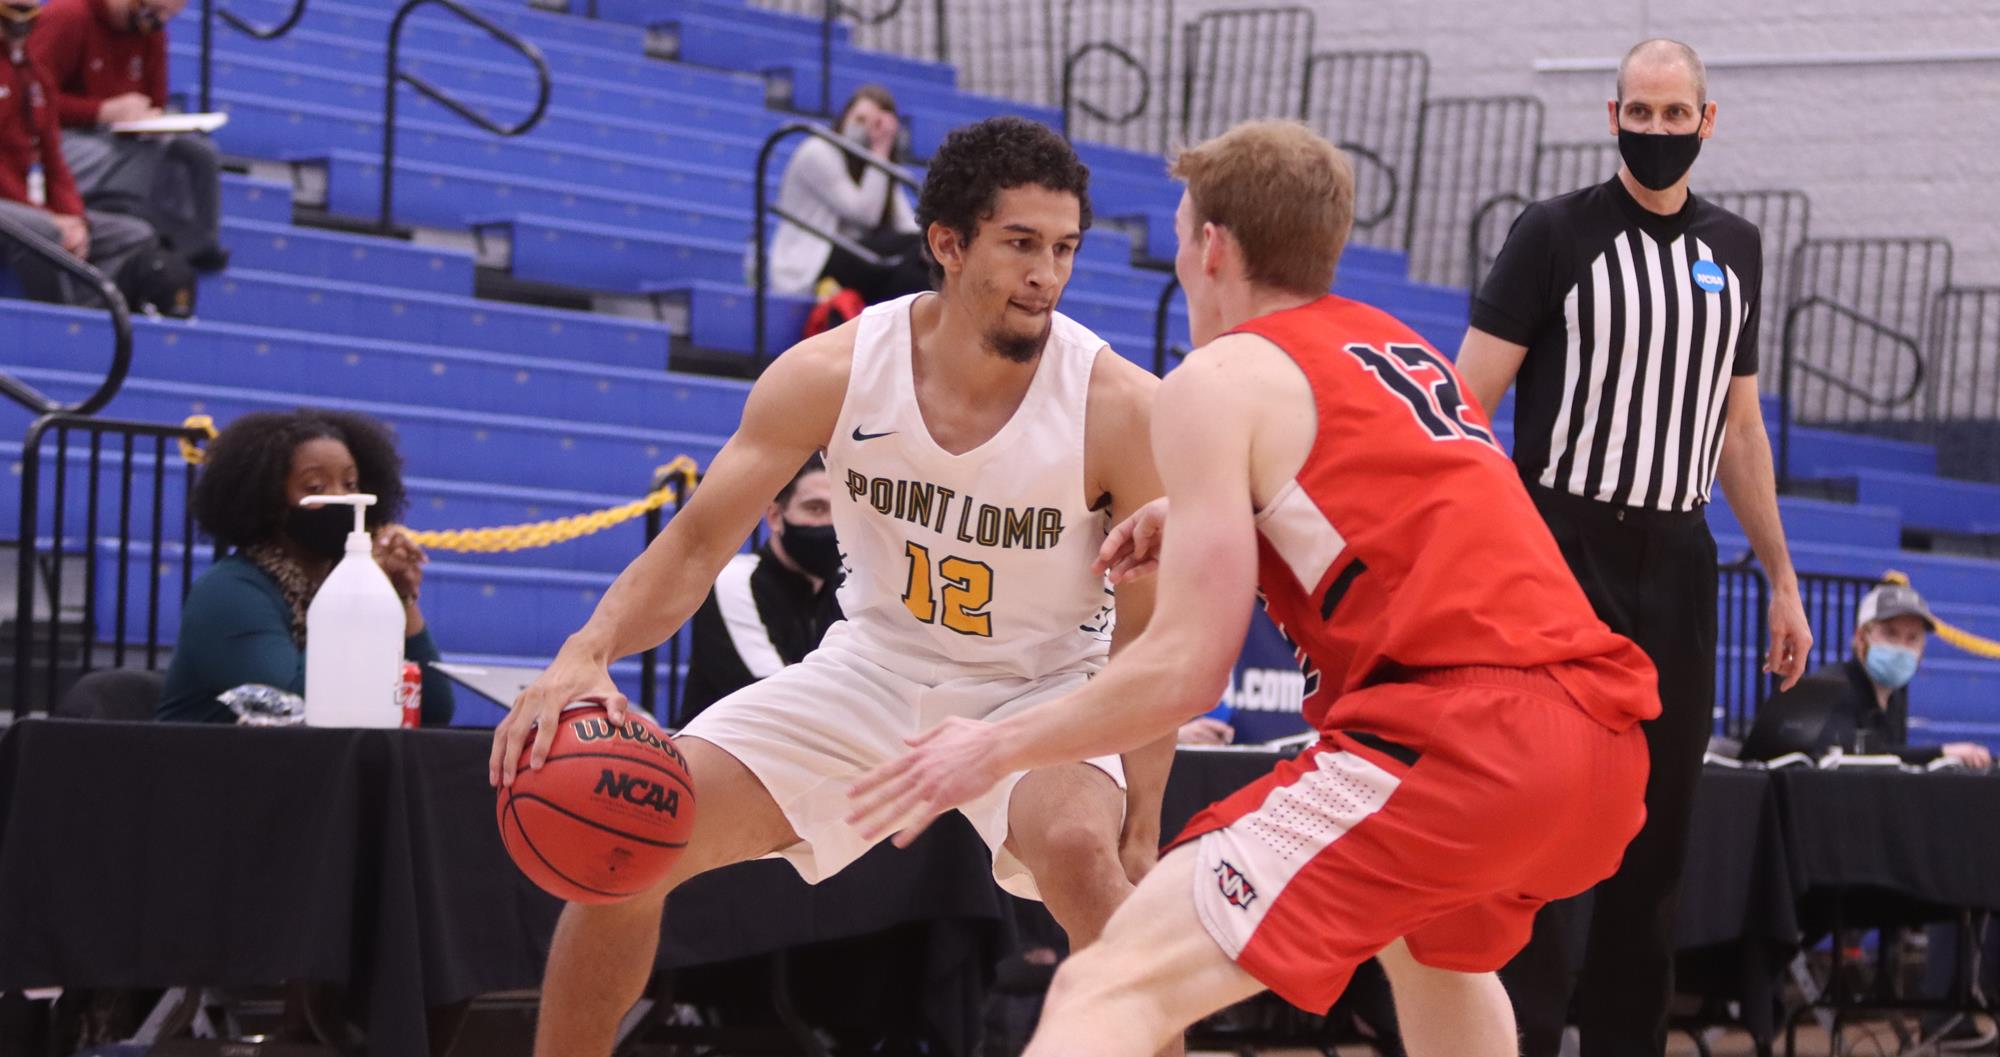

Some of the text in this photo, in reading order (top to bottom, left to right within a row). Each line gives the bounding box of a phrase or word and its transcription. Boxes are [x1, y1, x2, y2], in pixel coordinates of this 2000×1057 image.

[1696, 273, 1725, 287] NCAA
[1343, 342, 1507, 458] 12
[845, 468, 1065, 550] POINT LOMA
[901, 540, 993, 637] 12
[1223, 667, 1306, 713] .com
[594, 768, 680, 818] NCAA
